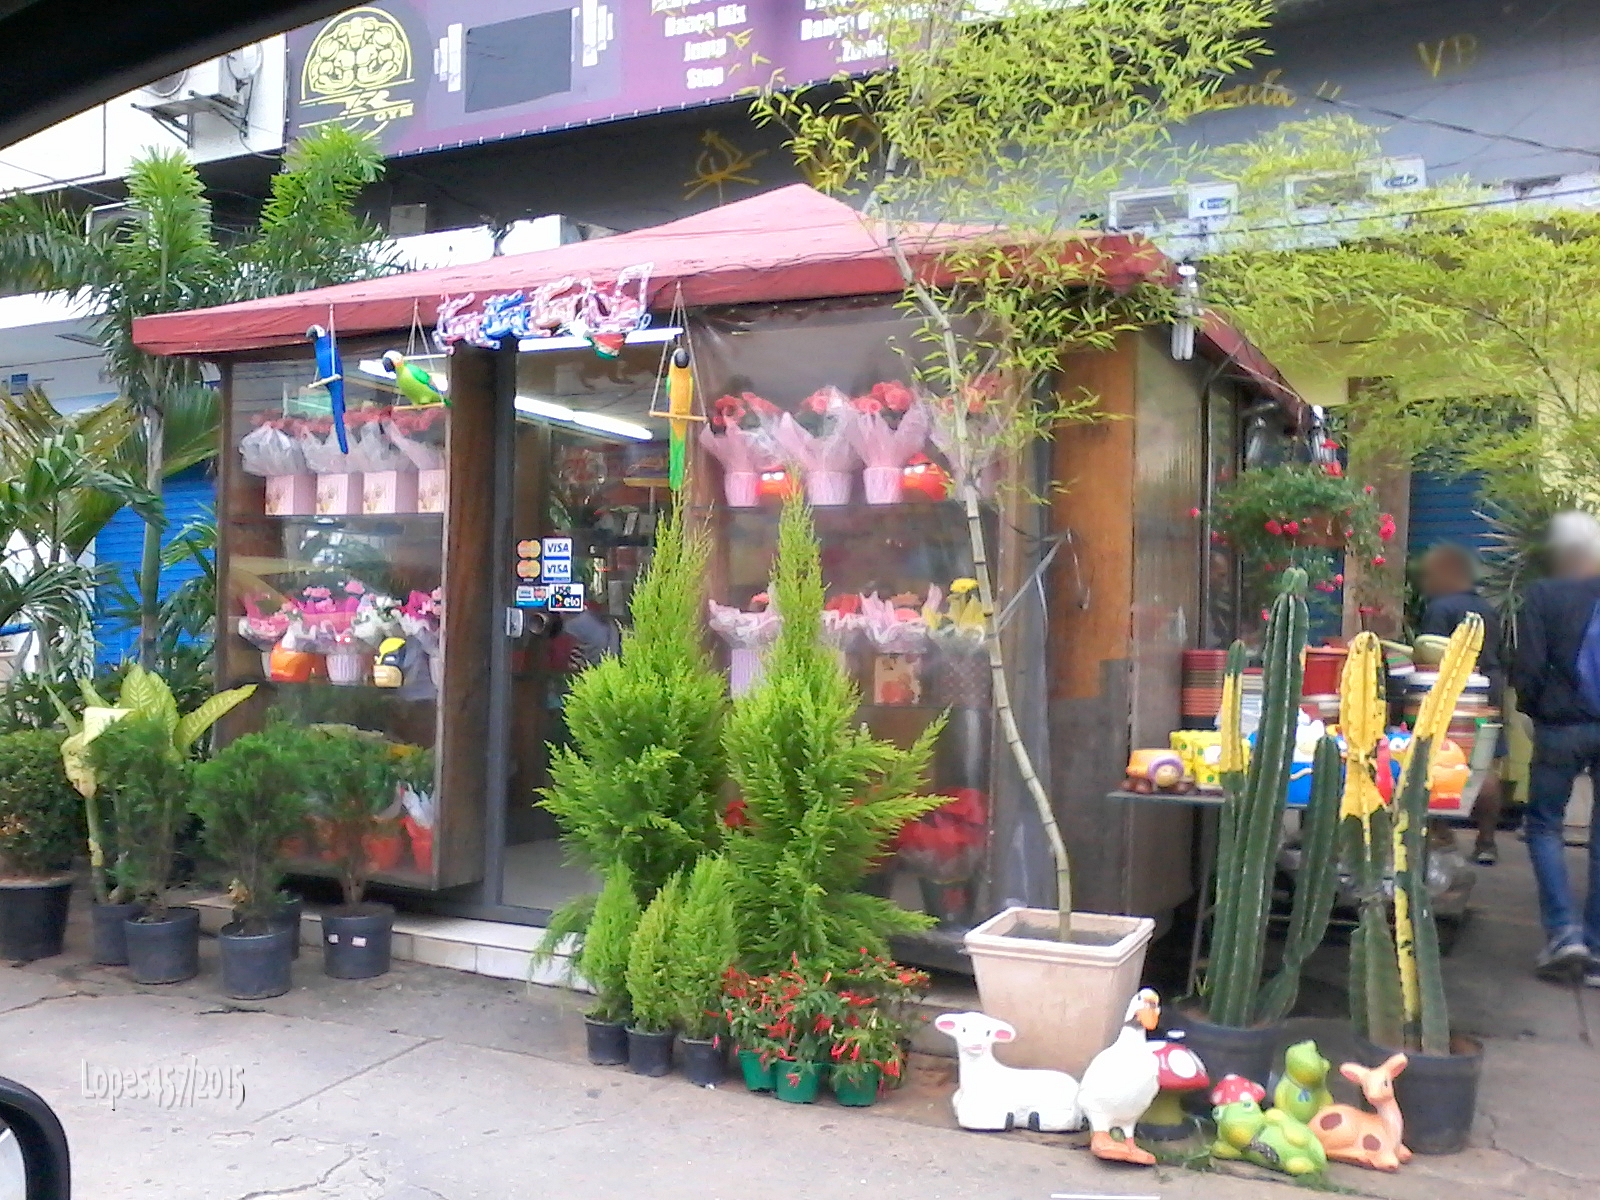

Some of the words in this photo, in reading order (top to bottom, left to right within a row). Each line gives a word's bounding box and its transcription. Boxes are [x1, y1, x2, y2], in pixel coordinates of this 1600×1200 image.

[841, 34, 894, 62] Zumb
[547, 543, 569, 552] VISA
[547, 564, 569, 573] VISA
